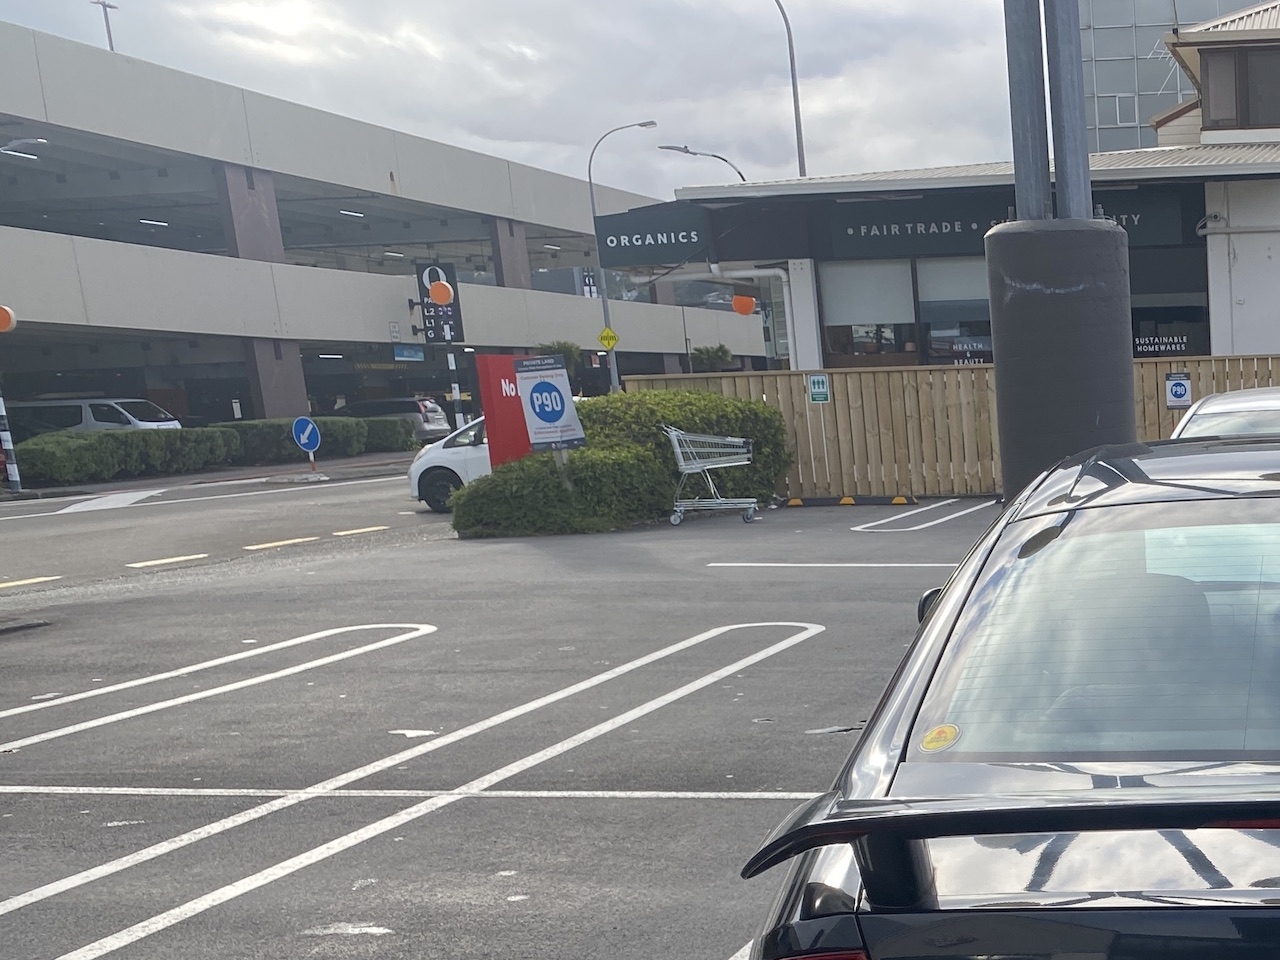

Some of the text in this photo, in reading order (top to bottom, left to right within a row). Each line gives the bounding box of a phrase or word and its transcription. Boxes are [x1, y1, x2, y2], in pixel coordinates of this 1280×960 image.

[860, 221, 963, 237] FAIR TRADE
[606, 231, 698, 247] ORGANICS
[424, 308, 435, 316] L2
[426, 319, 435, 327] L1
[427, 330, 435, 338] G
[1135, 335, 1188, 344] SUSTAINABLE
[952, 343, 983, 351] HEALTH
[1137, 344, 1186, 352] HOMEWARES
[954, 358, 984, 366] BEAUTY
[501, 378, 516, 397] No
[1172, 386, 1186, 395] P90
[532, 391, 562, 413] P90
